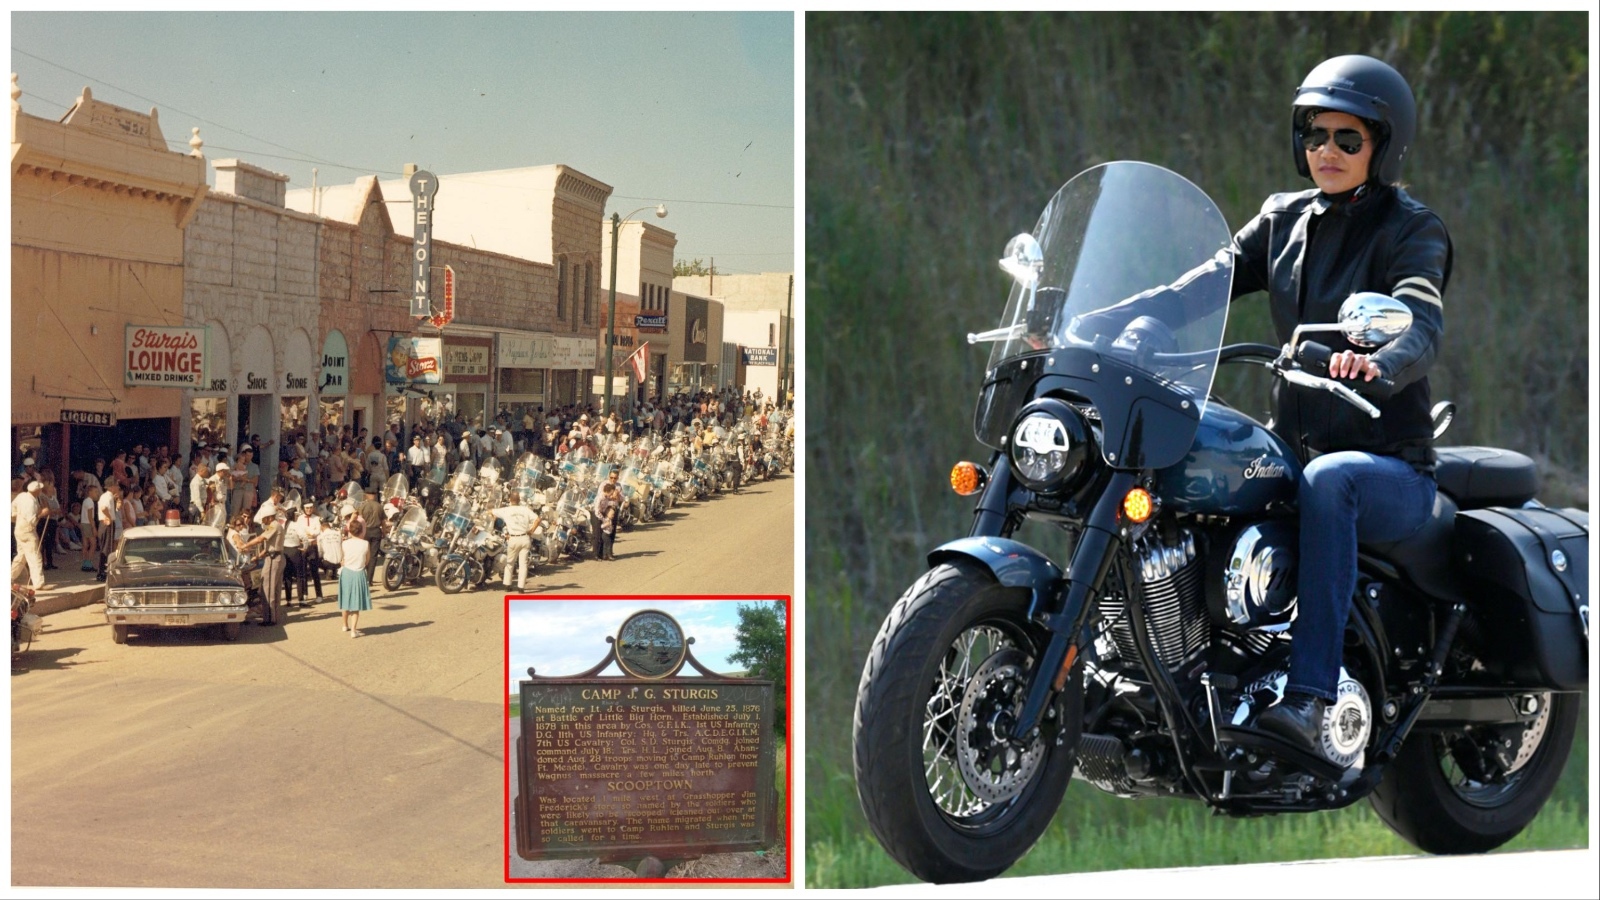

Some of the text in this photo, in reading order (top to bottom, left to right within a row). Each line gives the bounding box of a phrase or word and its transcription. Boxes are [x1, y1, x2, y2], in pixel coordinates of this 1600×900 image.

[415, 180, 428, 310] THE JOINT
[132, 328, 198, 353] Sturgis
[128, 351, 202, 373] LOUNGE
[322, 354, 345, 368] JOINT
[409, 360, 435, 375] Storz
[135, 372, 194, 382] MIXED DRINKS
[247, 372, 267, 389] SHOE
[286, 372, 308, 389] STORE
[62, 411, 108, 424] LIQUORS
[1244, 454, 1284, 479] Indian
[582, 689, 621, 699] CAMP
[628, 689, 637, 699] J.
[644, 689, 656, 699] G.
[663, 689, 718, 699] STURGIS
[630, 714, 644, 722] Big
[620, 722, 631, 730] by
[735, 737, 760, 745] joined
[581, 747, 600, 755] July
[665, 746, 692, 754] joined
[637, 754, 666, 762] moving
[538, 773, 571, 781] Wagnus
[608, 780, 693, 790] SCOOPTOWN
[675, 815, 712, 824] migrated
